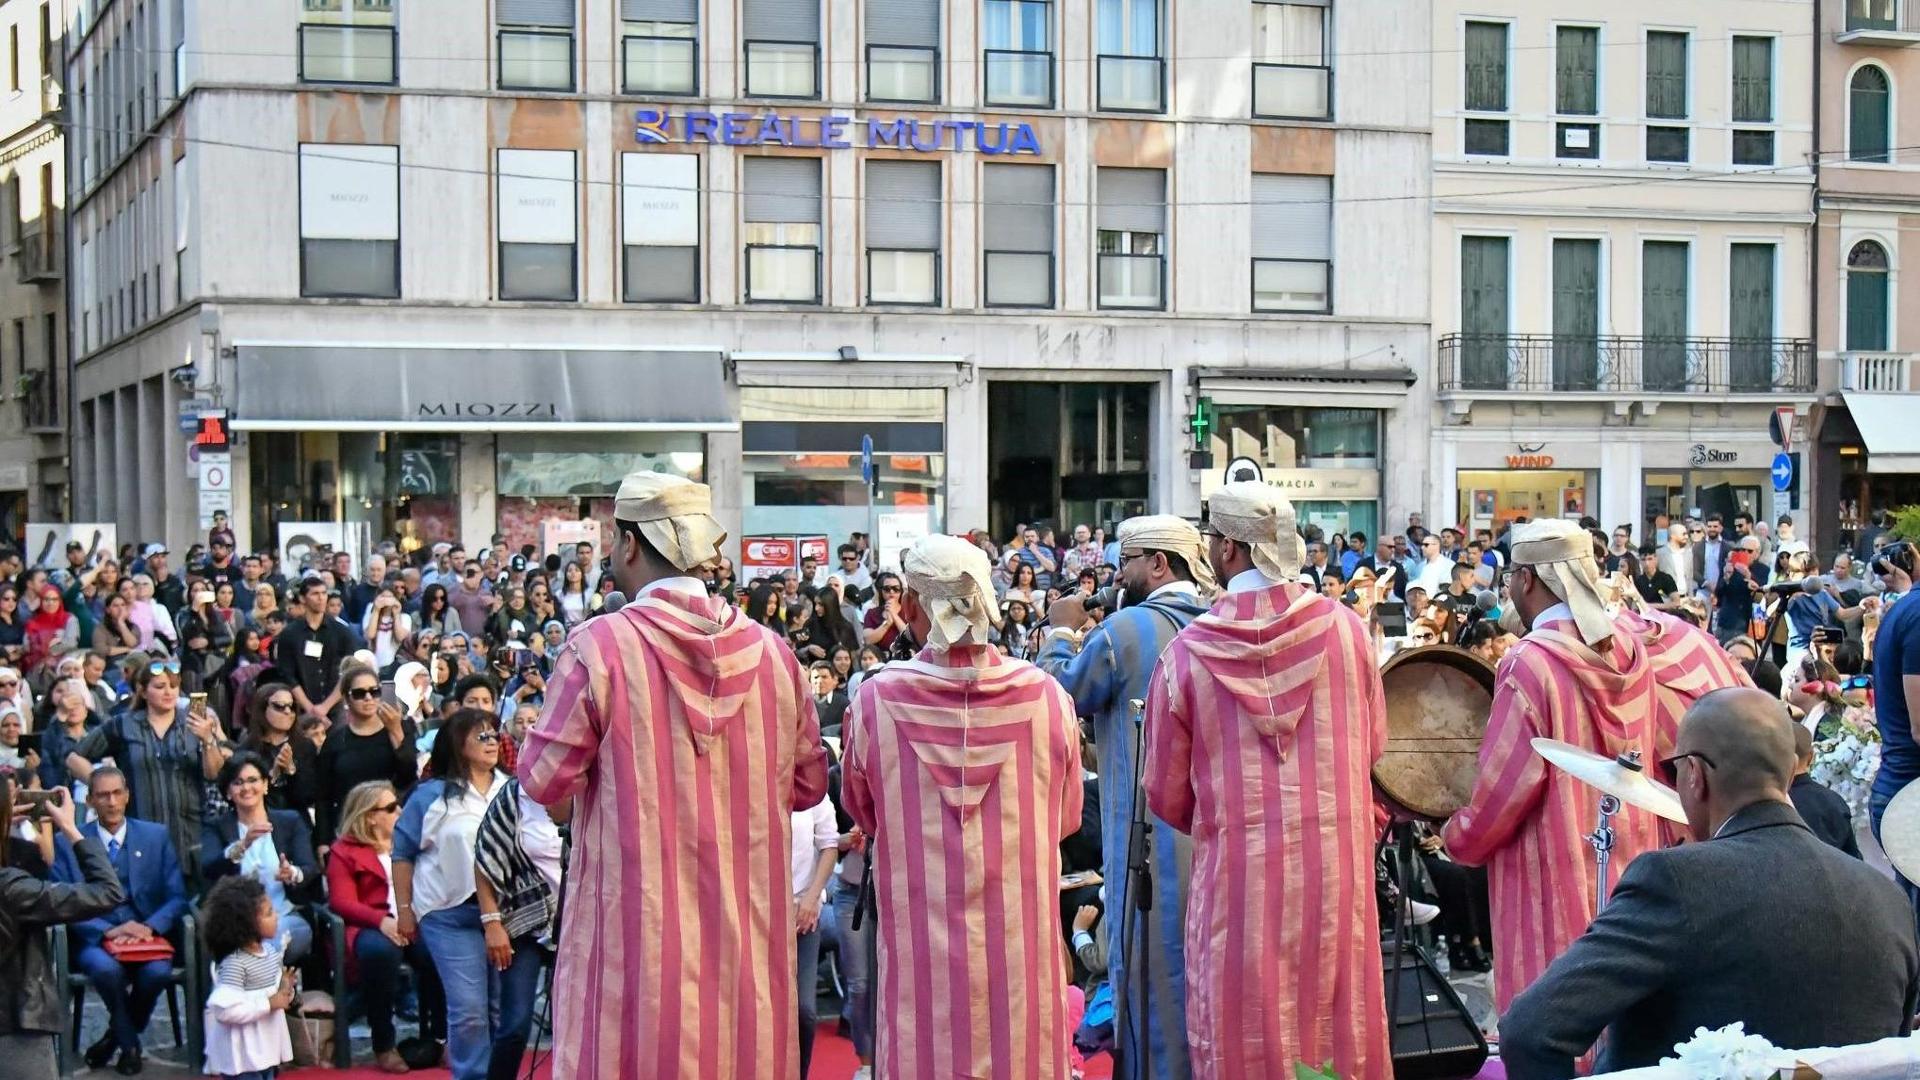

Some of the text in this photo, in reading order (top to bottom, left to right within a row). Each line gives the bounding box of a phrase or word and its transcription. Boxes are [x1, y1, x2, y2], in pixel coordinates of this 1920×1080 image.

[685, 111, 1042, 156] REALE MUTUA
[418, 402, 557, 416] MIOZZI
[1504, 454, 1554, 469] WIND
[1708, 448, 1738, 462] Store
[1267, 479, 1315, 489] RMACIA
